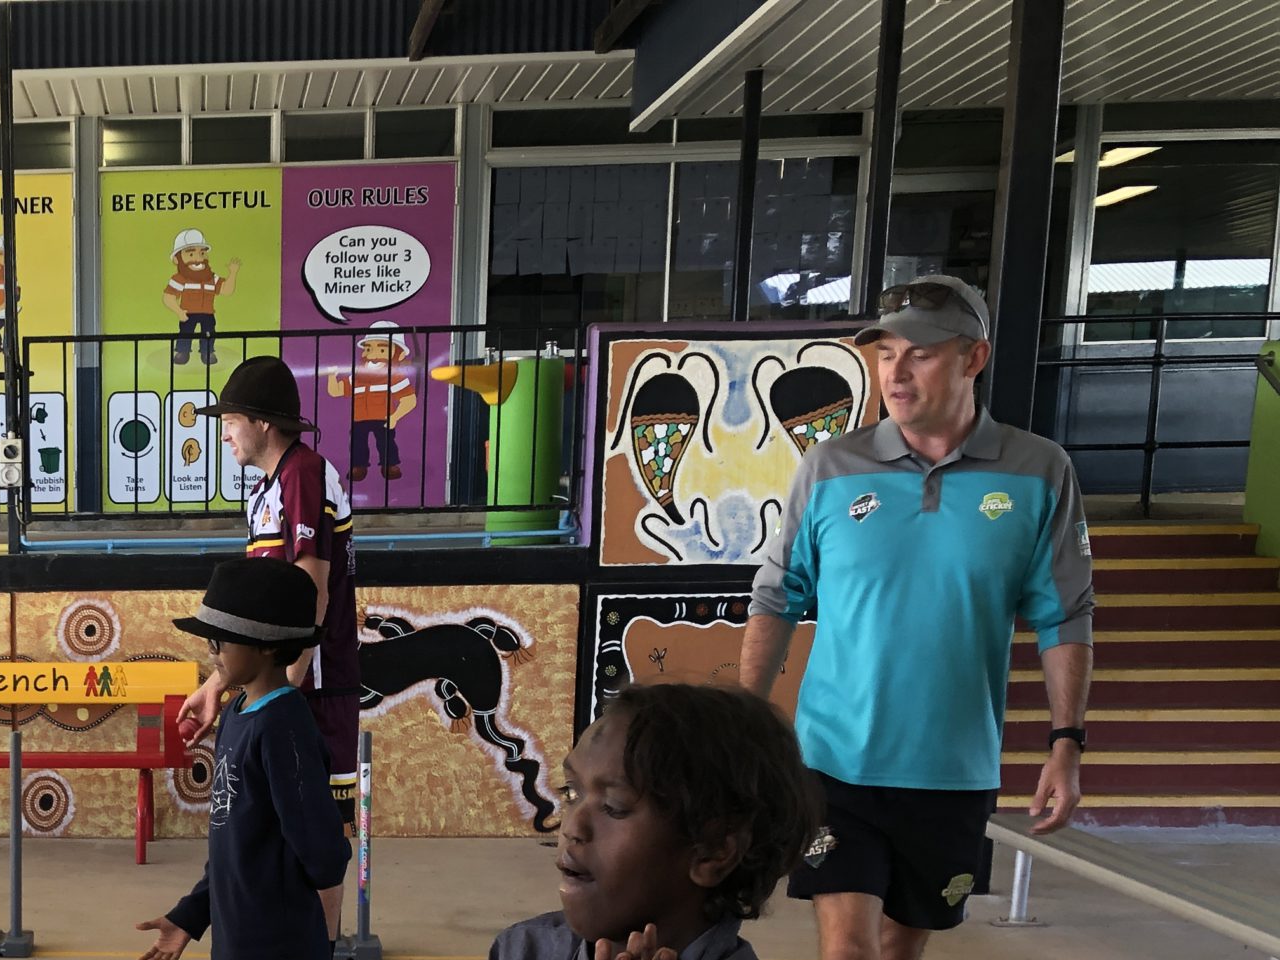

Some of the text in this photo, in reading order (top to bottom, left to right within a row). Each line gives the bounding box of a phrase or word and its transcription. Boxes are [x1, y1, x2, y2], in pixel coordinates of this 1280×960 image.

[112, 190, 271, 211] BE RESPECTFUL
[308, 187, 428, 207] OUR RULES
[339, 235, 396, 250] Can you
[325, 249, 412, 263] follow our 3
[334, 265, 400, 278] Rules like
[324, 280, 411, 294] Miner Mick?
[35, 476, 65, 484] rubbish
